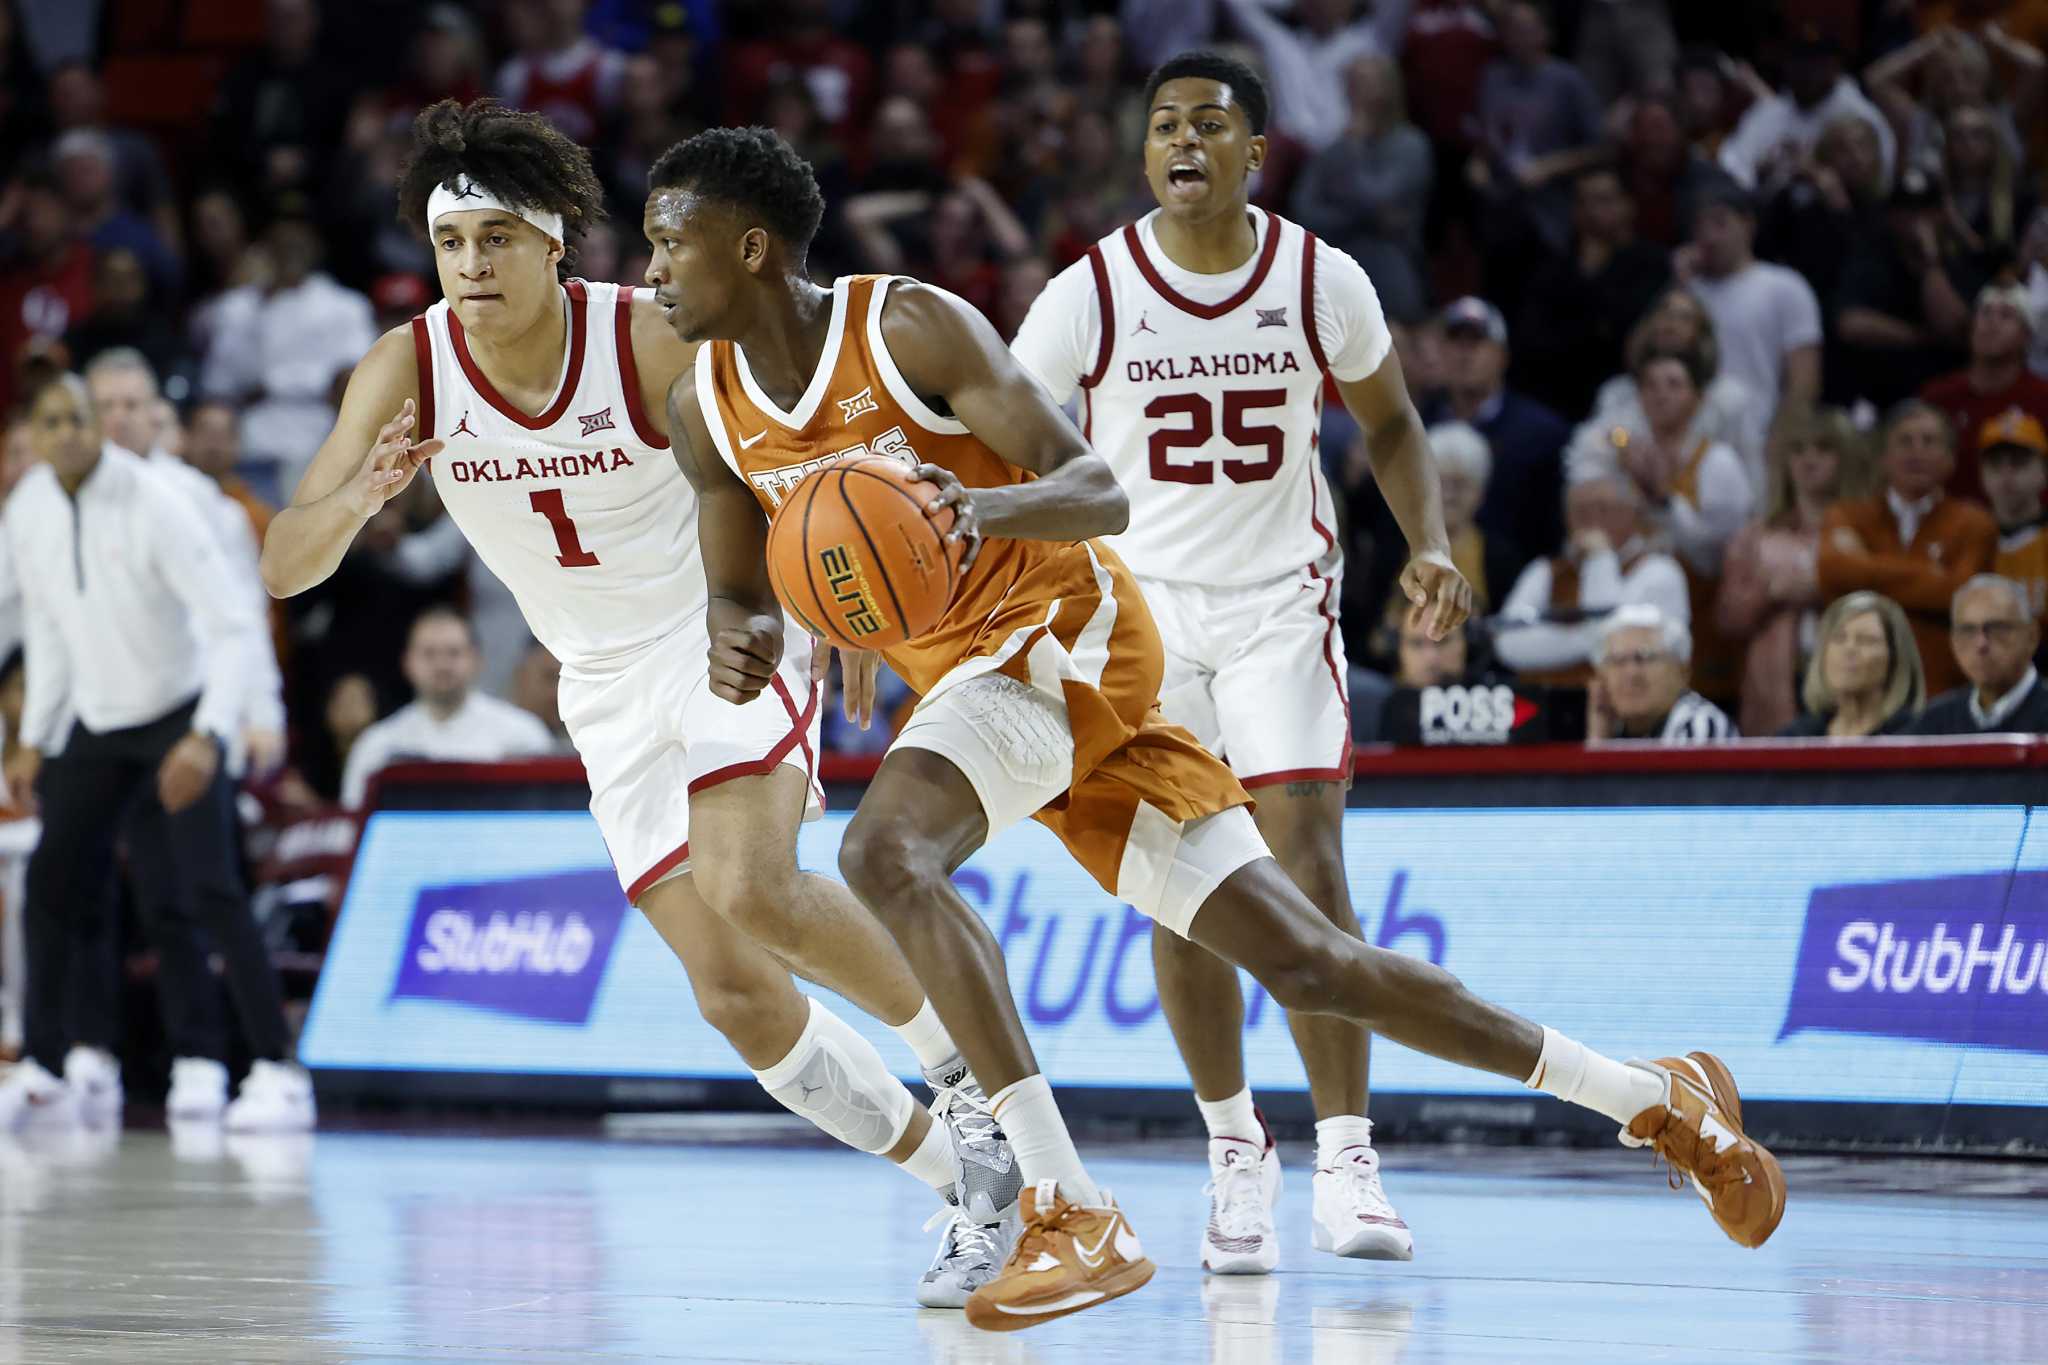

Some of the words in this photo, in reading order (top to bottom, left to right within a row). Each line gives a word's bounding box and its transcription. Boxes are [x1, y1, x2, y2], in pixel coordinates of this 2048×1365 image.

[1127, 351, 1300, 382] OKLAHOMA
[451, 448, 634, 483] OKLAHOMA
[1144, 388, 1287, 485] 25
[529, 489, 600, 567] 1
[821, 545, 880, 636] ELITE
[1421, 684, 1515, 731] POSS
[1828, 921, 2048, 994] StubHu
